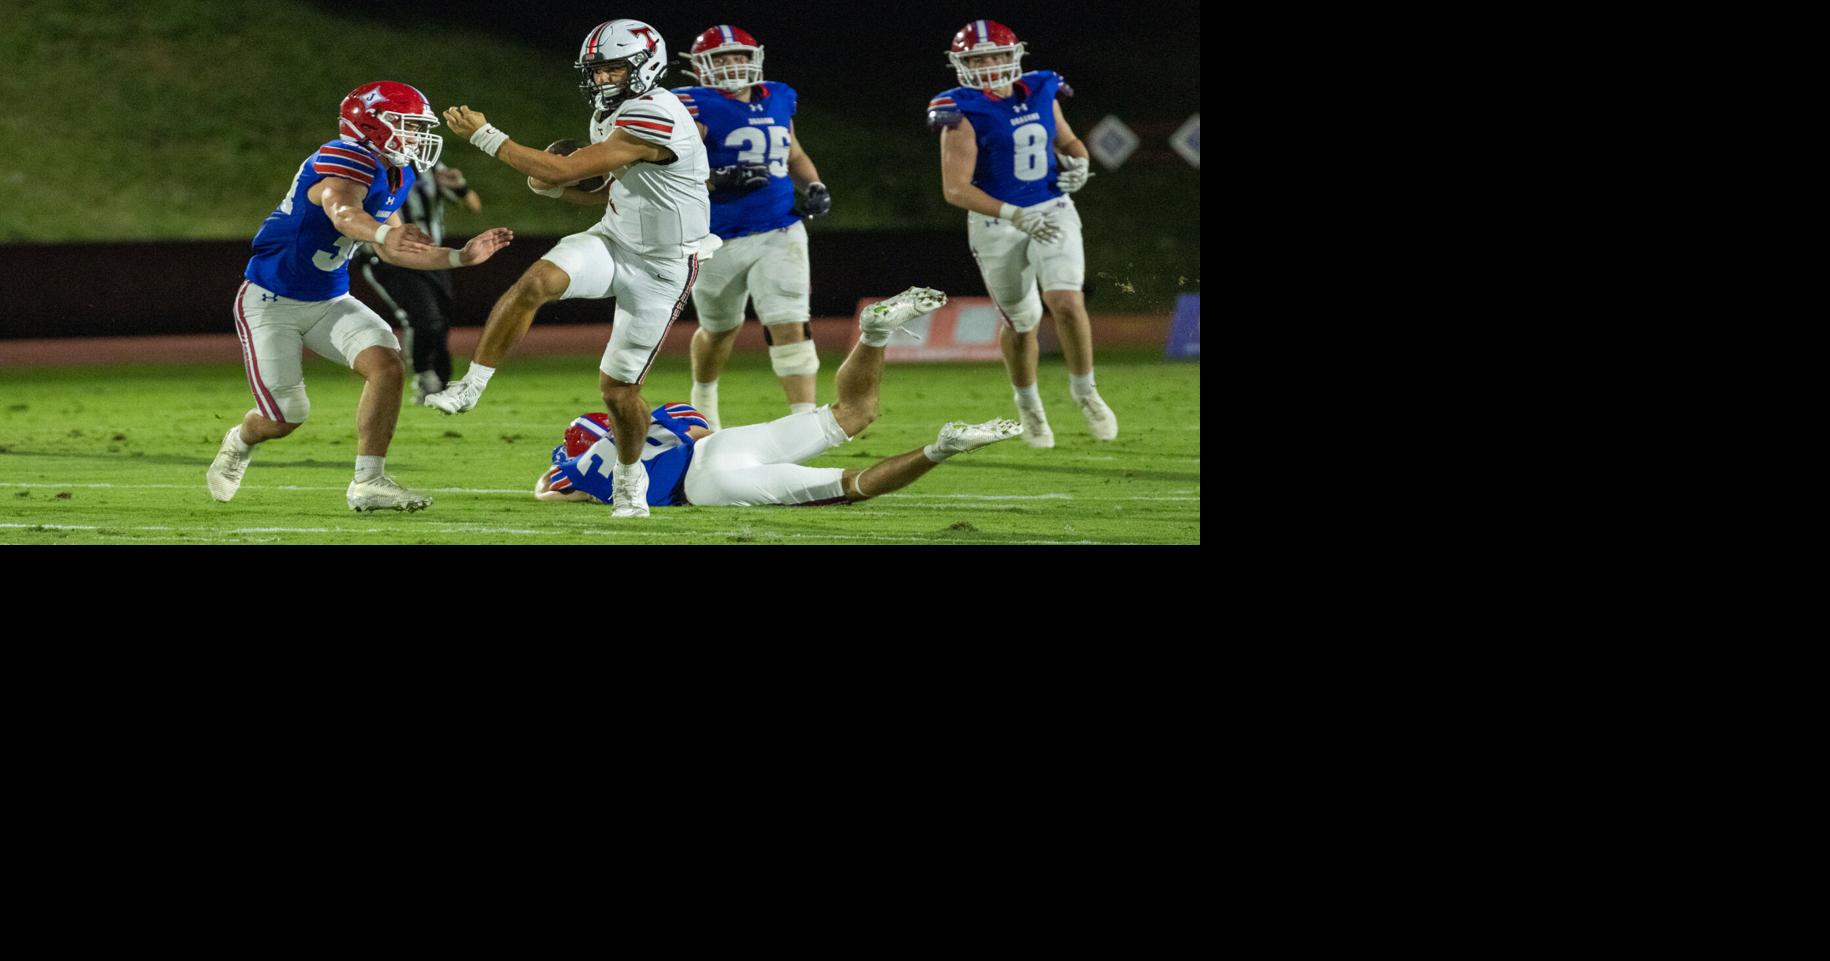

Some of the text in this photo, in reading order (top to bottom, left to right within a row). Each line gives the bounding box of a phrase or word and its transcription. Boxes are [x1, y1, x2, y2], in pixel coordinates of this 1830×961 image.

[627, 26, 657, 54] T
[366, 93, 376, 101] J
[724, 126, 791, 178] 35
[1012, 122, 1049, 181] 8
